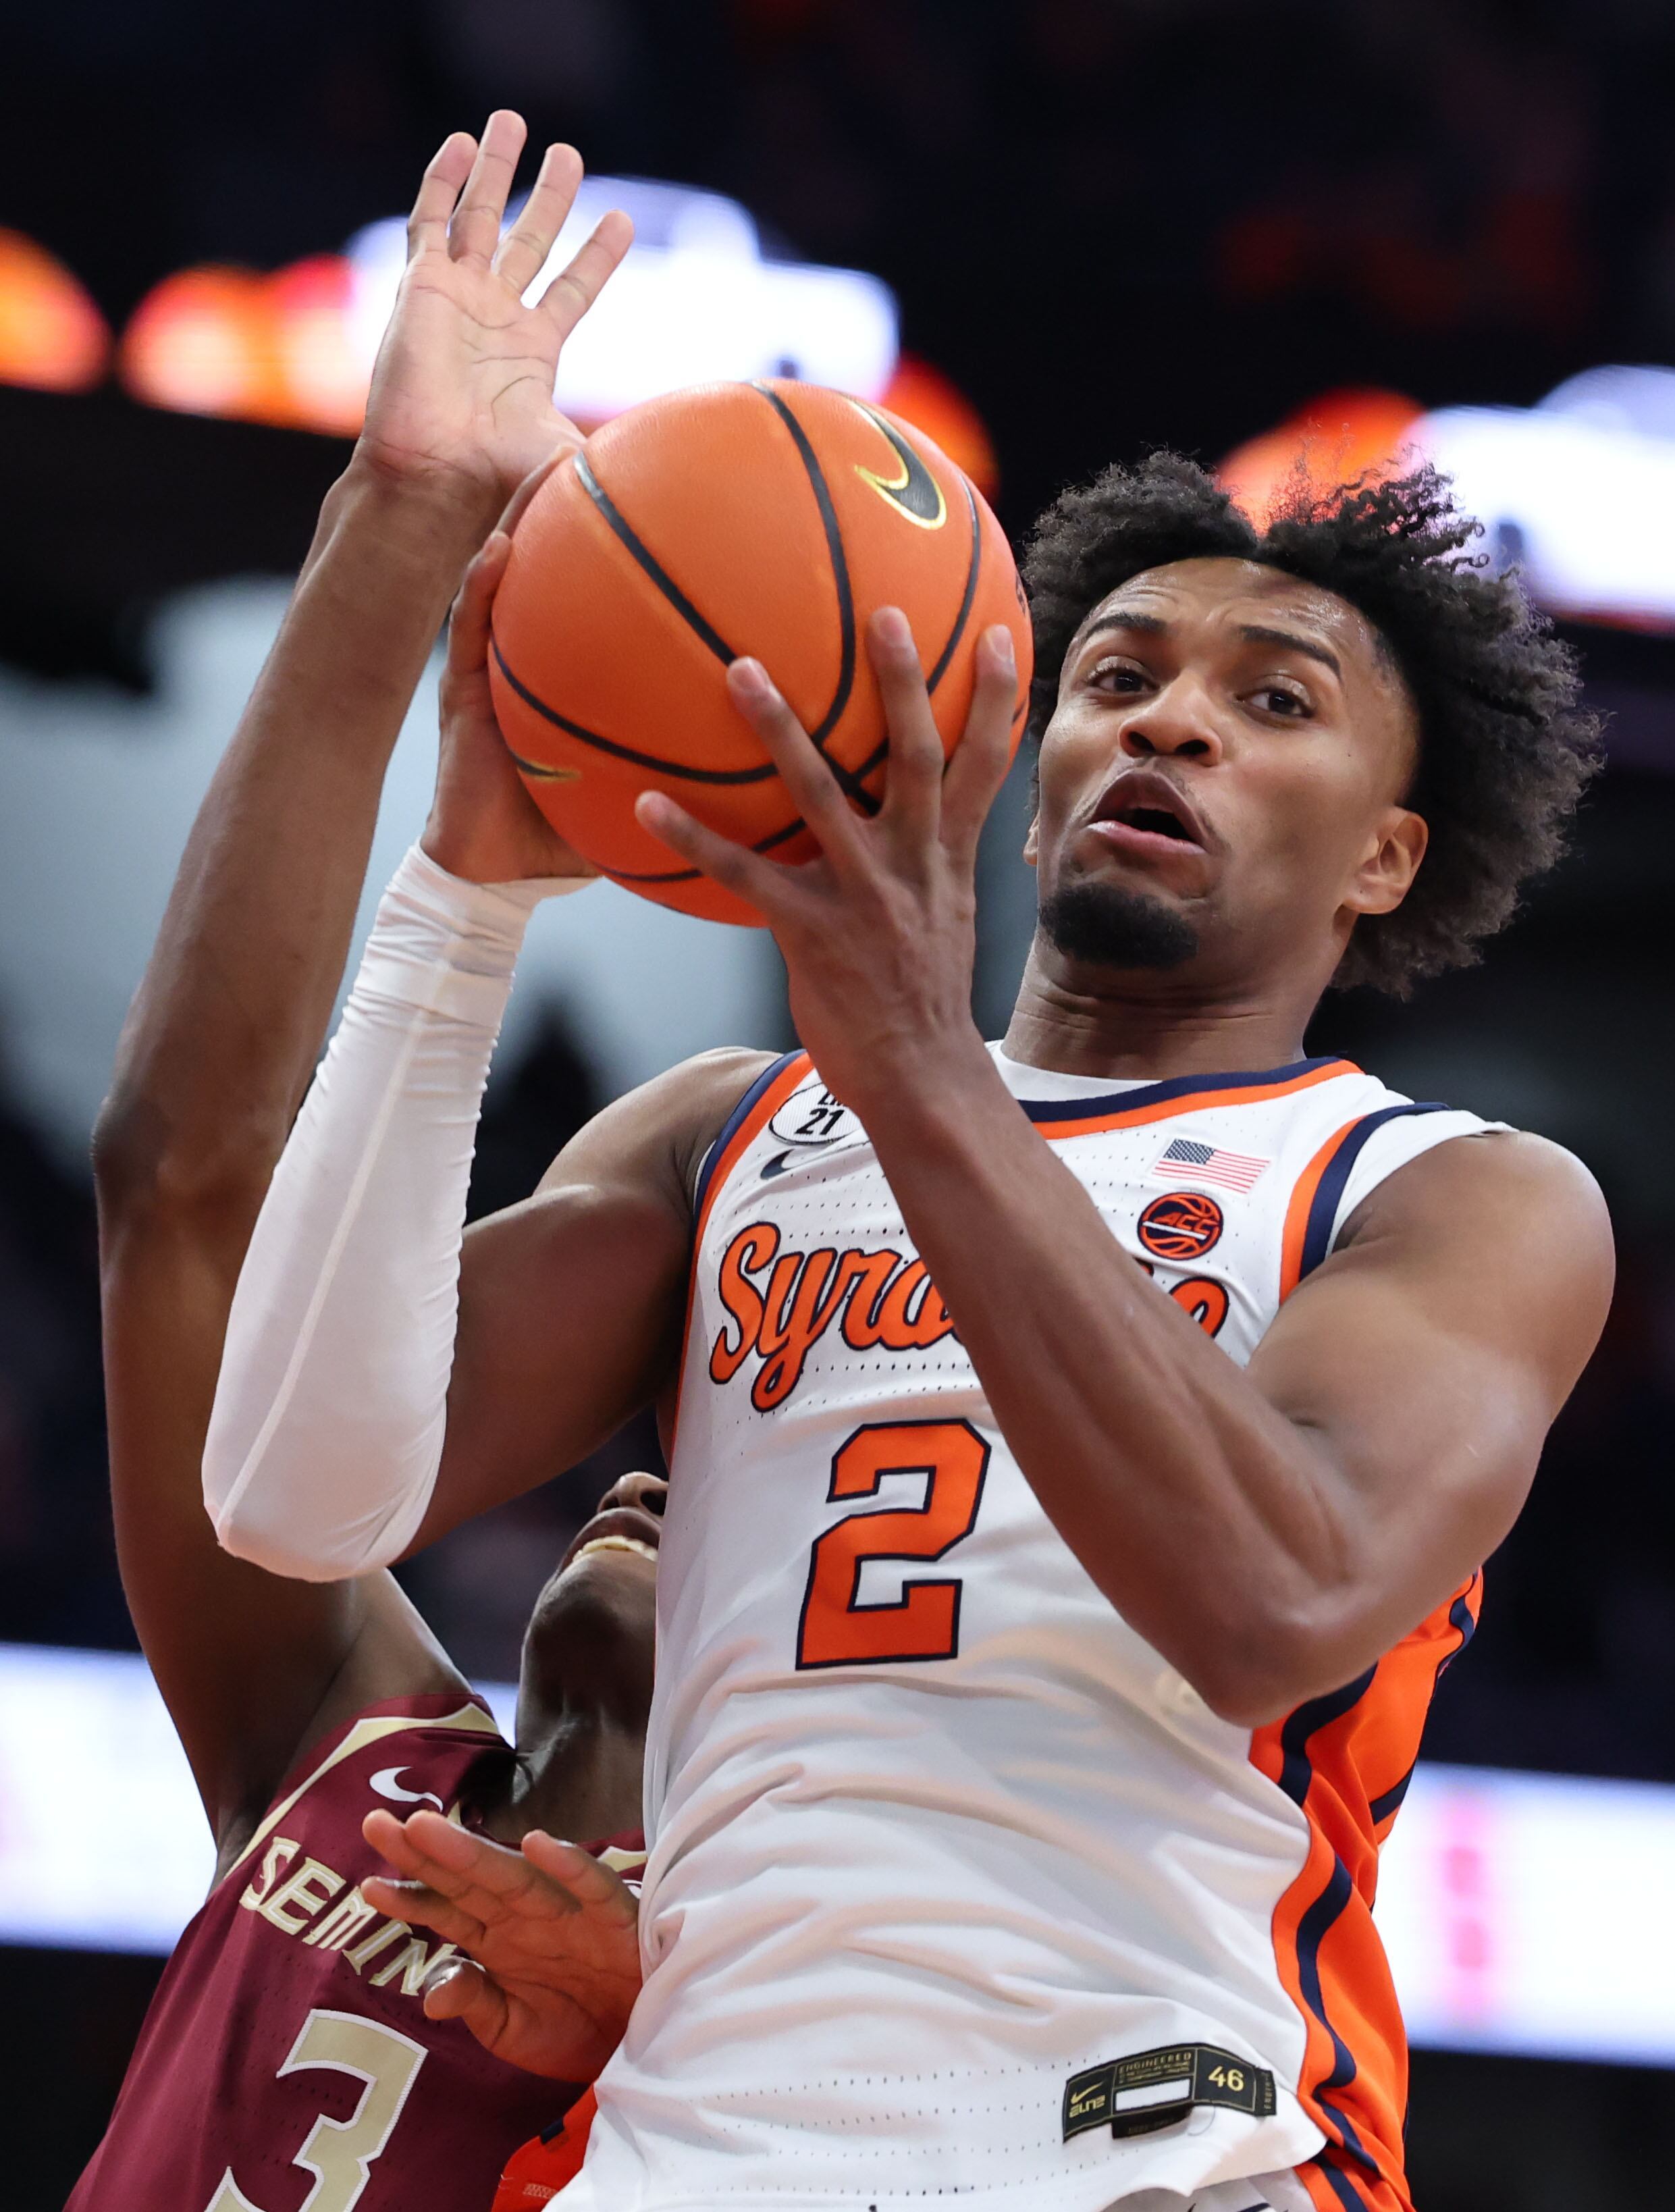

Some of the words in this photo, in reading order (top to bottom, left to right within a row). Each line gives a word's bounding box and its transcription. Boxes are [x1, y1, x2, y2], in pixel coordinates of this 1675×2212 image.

[795, 1108, 845, 1135] 21
[1153, 1211, 1219, 1236] ACC
[795, 1418, 992, 1671] 2
[239, 1836, 458, 1997] SEMIN
[203, 2008, 429, 2212] 3
[1208, 2065, 1244, 2092] 46
